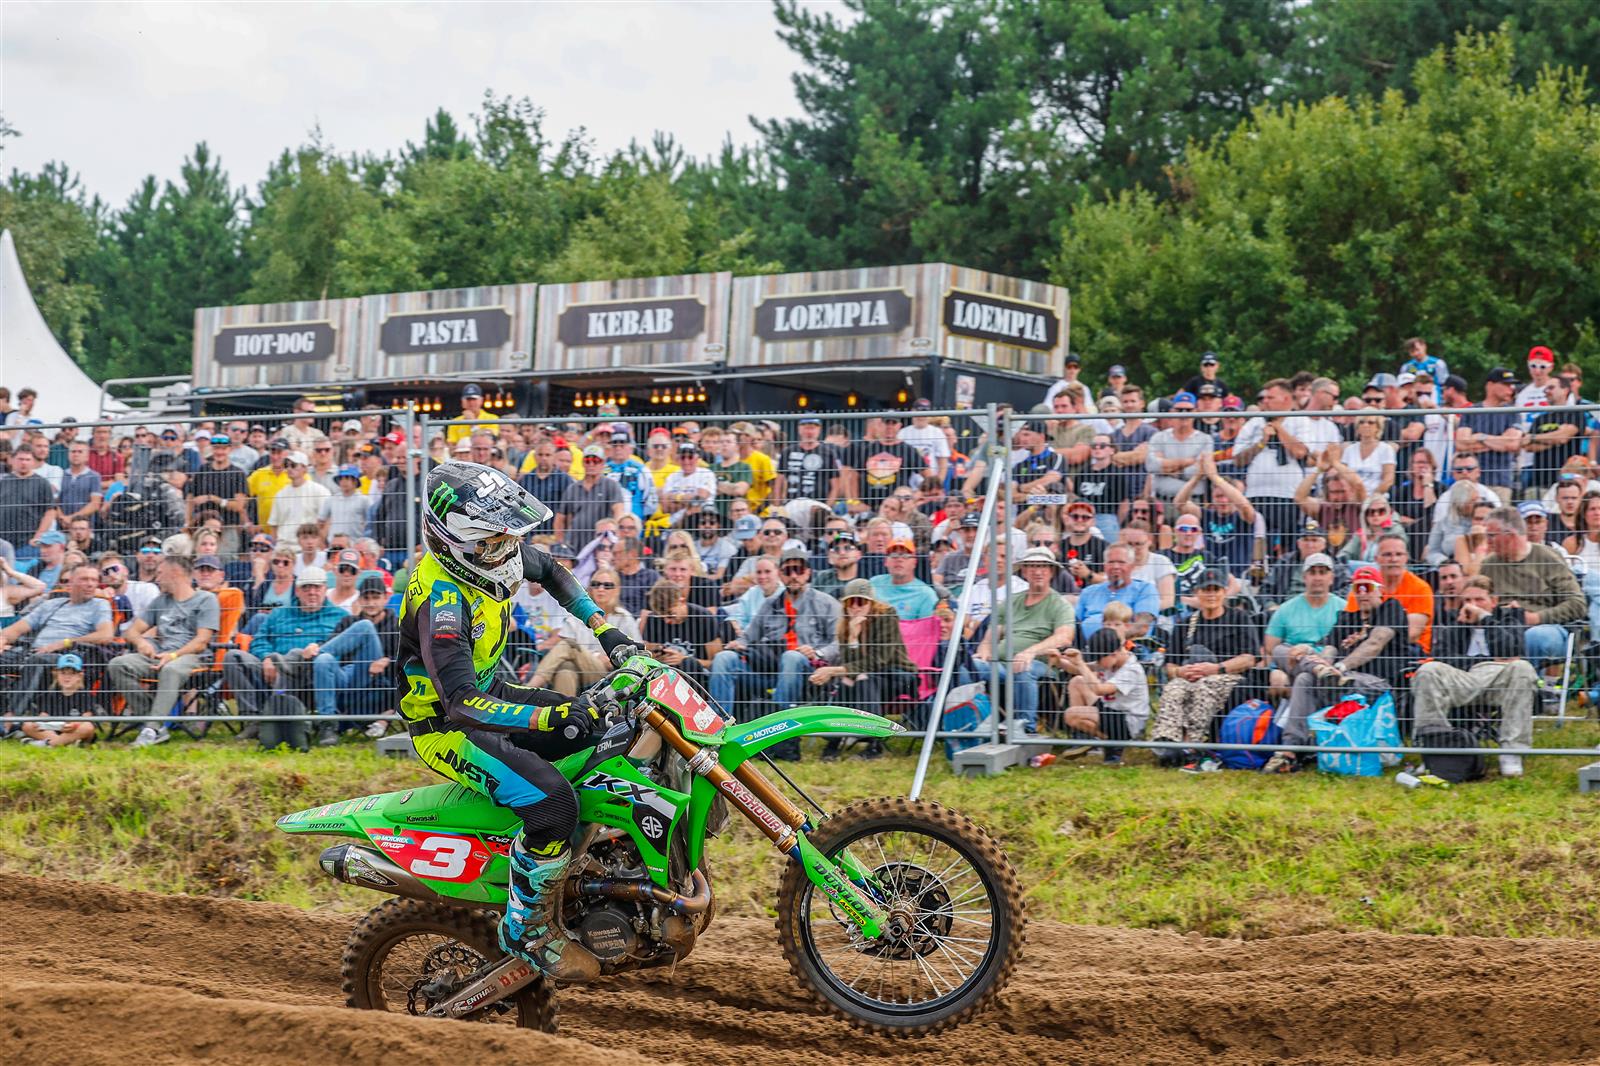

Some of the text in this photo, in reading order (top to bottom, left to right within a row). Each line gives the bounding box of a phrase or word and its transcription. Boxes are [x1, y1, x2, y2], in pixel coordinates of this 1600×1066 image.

[587, 308, 674, 339] KEBAB
[773, 300, 889, 332] LOEMPIA
[953, 299, 1047, 342] LOEMPIA
[233, 331, 316, 357] HOT-DOG
[409, 318, 479, 346] PASTA
[463, 696, 525, 715] JUST1
[753, 721, 788, 739] MOTOREX
[584, 771, 657, 804] KX
[739, 792, 783, 833] SHOWA
[381, 835, 408, 843] MOTOREX
[410, 836, 472, 879] 3
[813, 861, 875, 919] DUNLOP
[587, 927, 621, 937] Kawasaki
